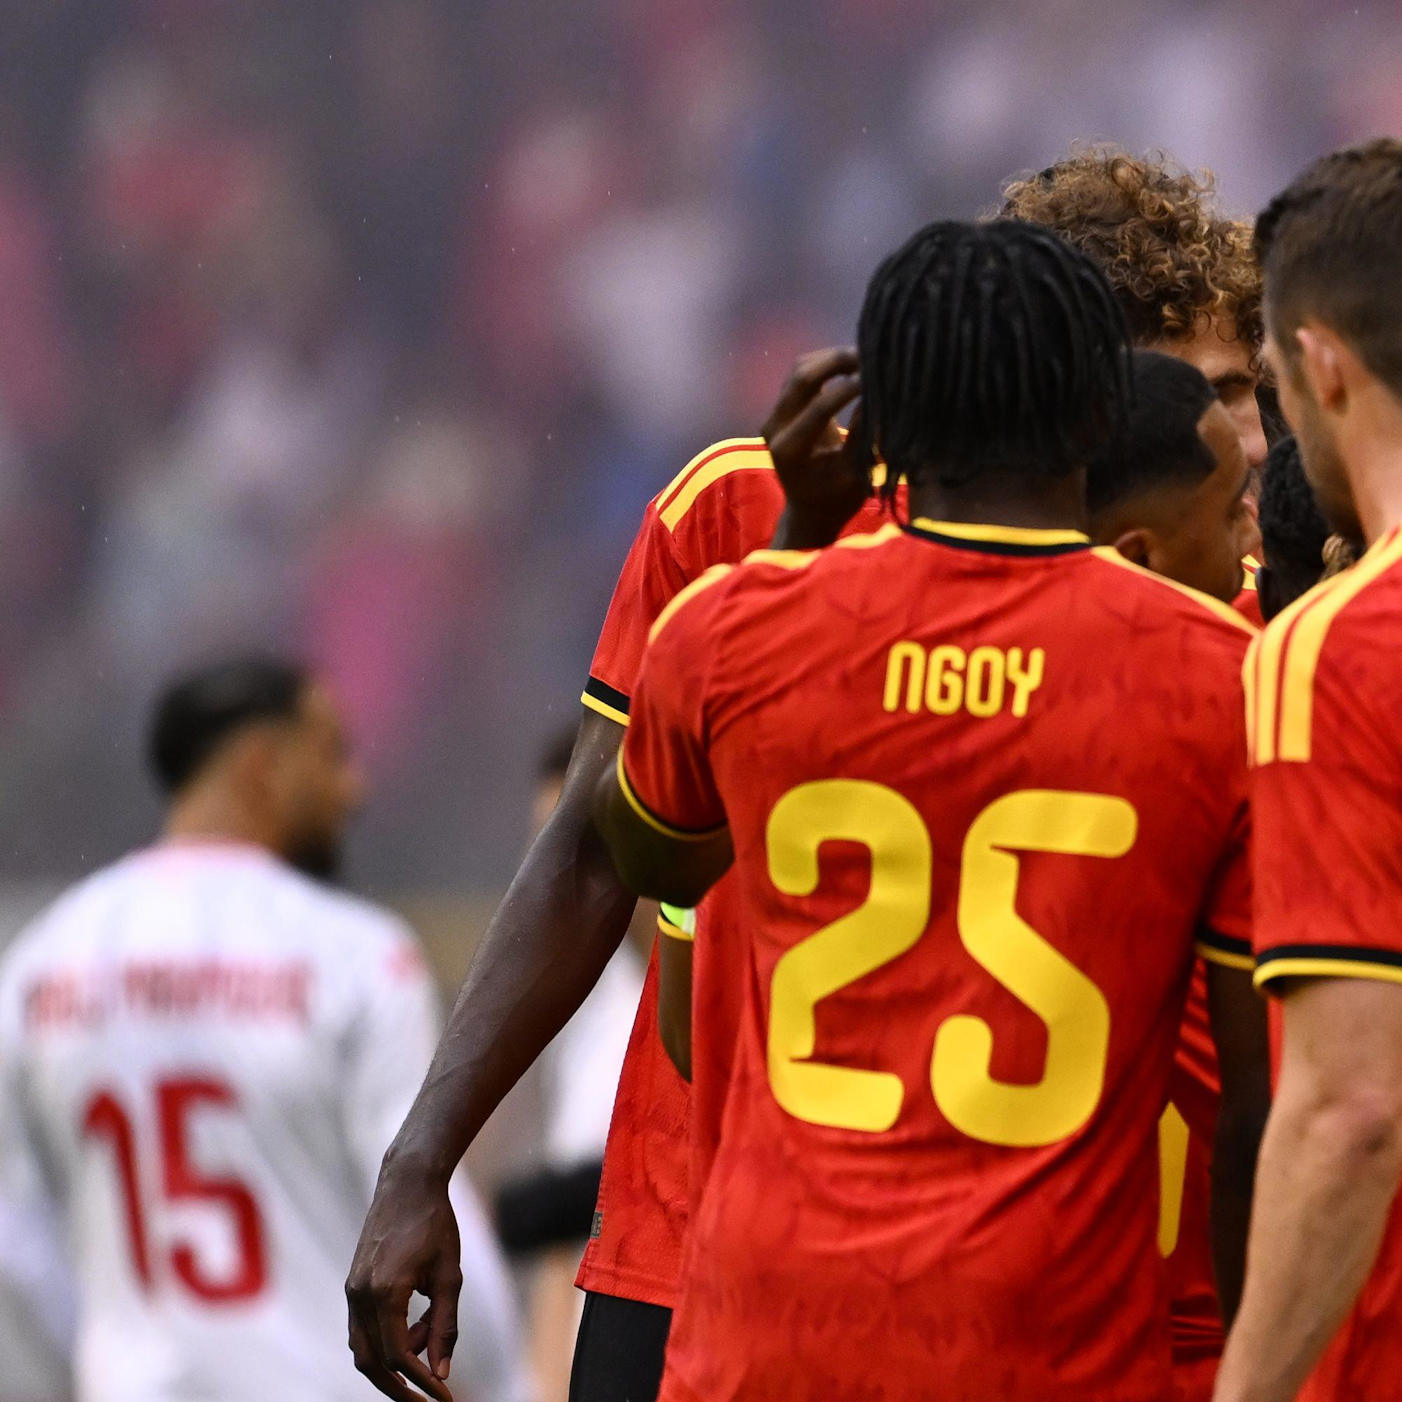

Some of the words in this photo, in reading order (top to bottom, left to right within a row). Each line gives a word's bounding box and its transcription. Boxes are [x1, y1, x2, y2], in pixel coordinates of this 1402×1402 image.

[883, 640, 1045, 718] NGOY
[767, 779, 1138, 1147] 25
[80, 1070, 268, 1308] 15
